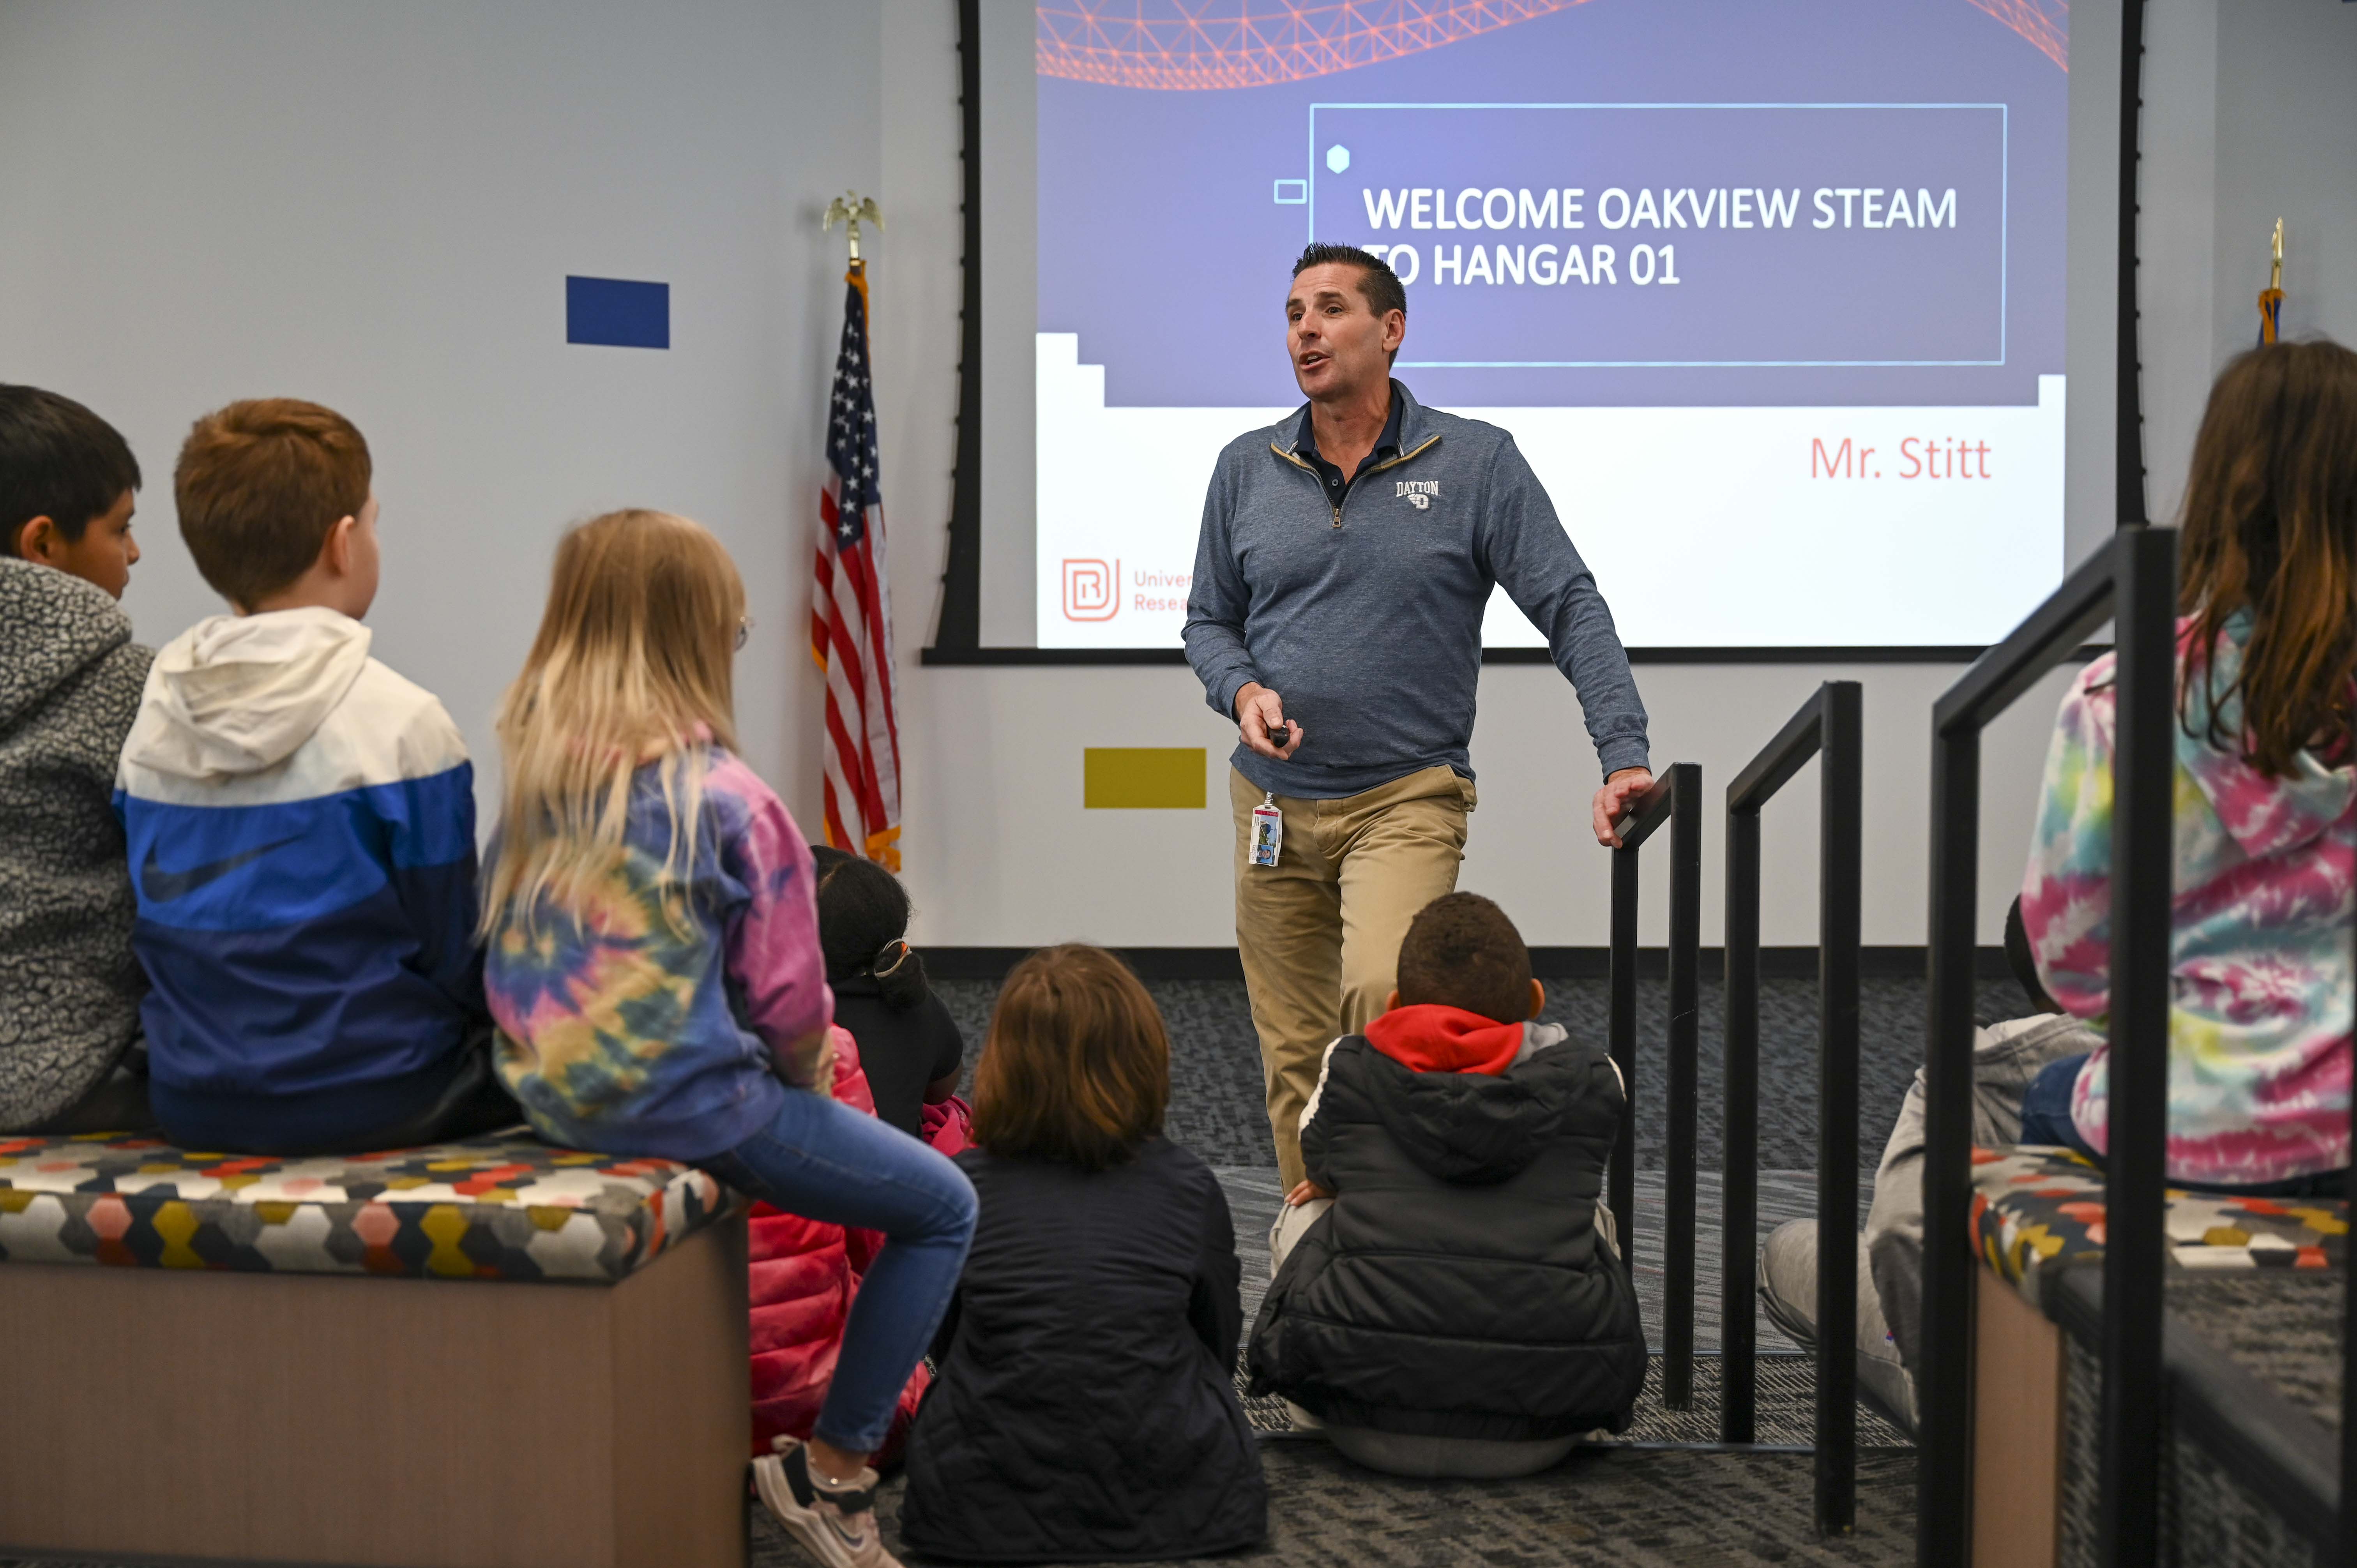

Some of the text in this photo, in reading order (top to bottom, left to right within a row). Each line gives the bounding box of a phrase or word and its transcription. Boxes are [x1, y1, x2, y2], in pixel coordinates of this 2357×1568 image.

[1362, 188, 1956, 230] WELCOME OAKVIEW STEAM
[1435, 244, 1617, 285] HANGAR
[1629, 244, 1680, 285] 01
[1812, 436, 1991, 479] Mr. Stitt
[1396, 481, 1439, 497] DAYTON
